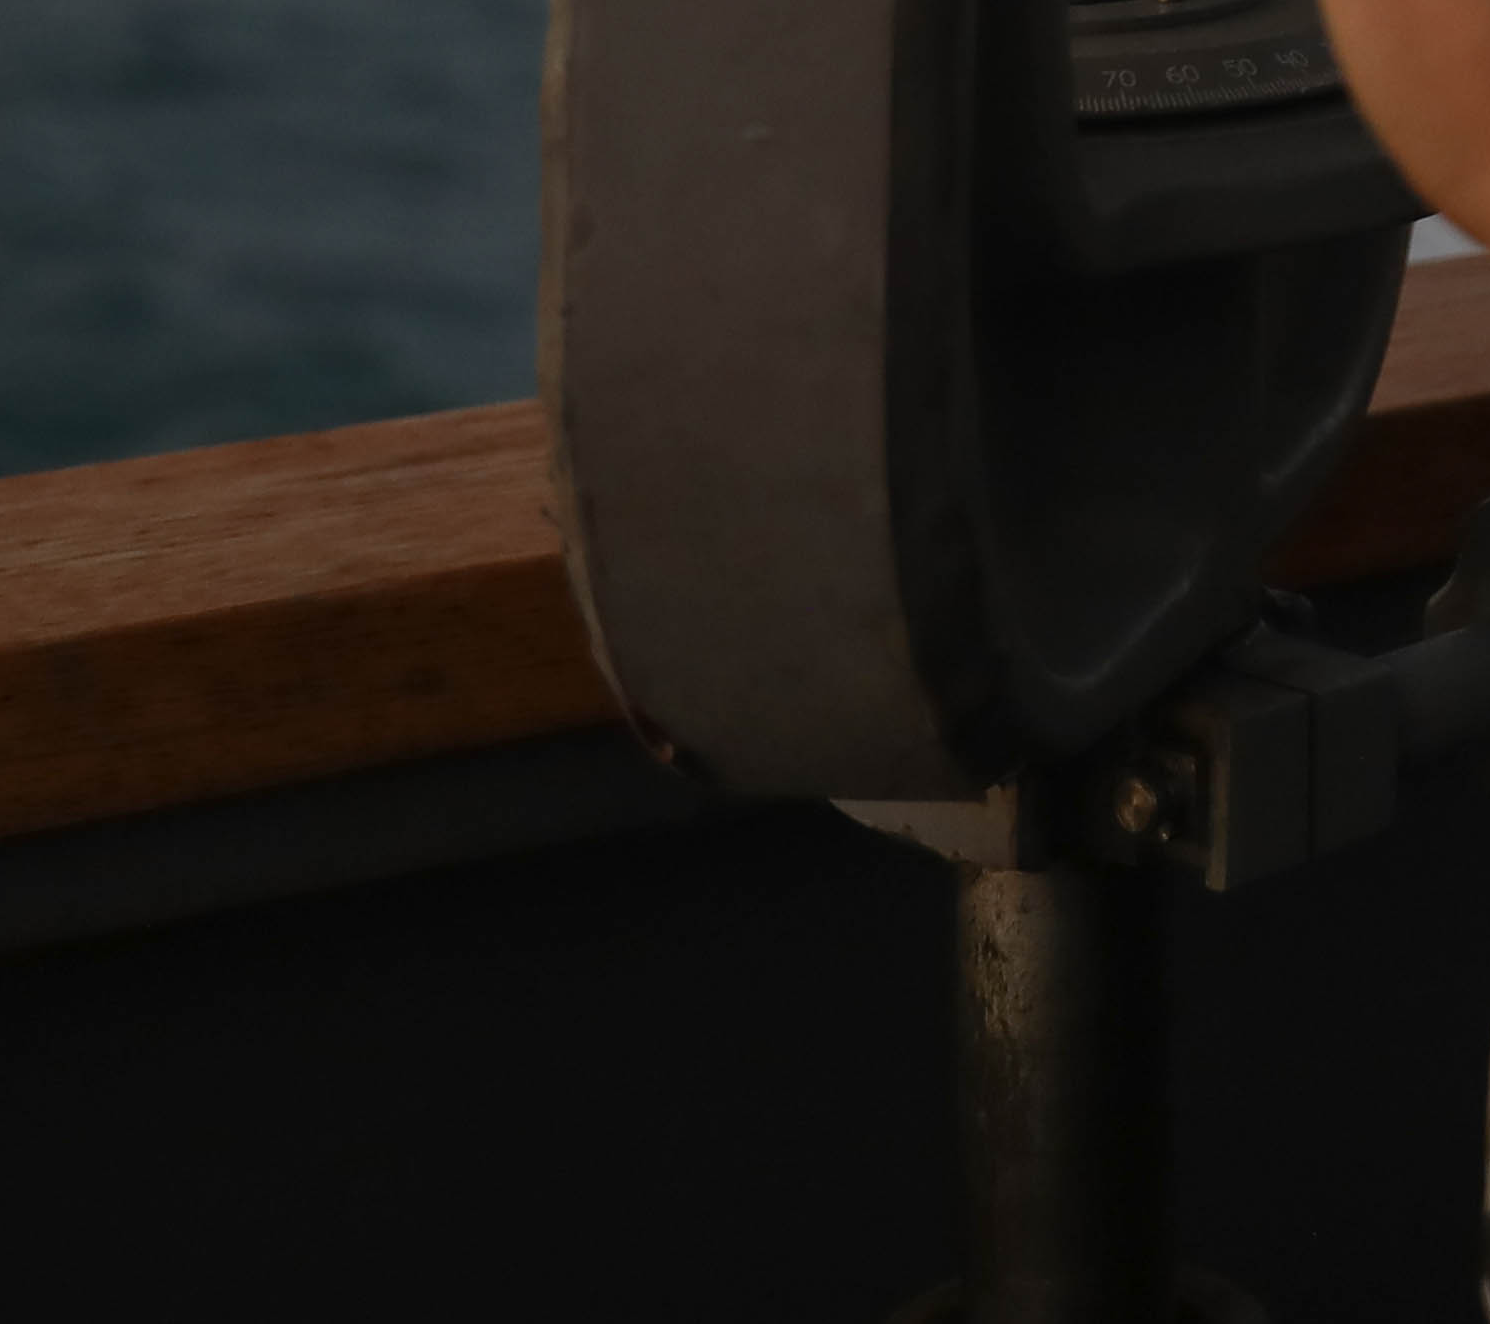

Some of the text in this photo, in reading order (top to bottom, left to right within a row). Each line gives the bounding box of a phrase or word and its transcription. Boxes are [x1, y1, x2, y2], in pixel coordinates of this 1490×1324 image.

[1099, 69, 1138, 88] 70
[1164, 63, 1201, 85] 60
[1221, 55, 1259, 79] 50
